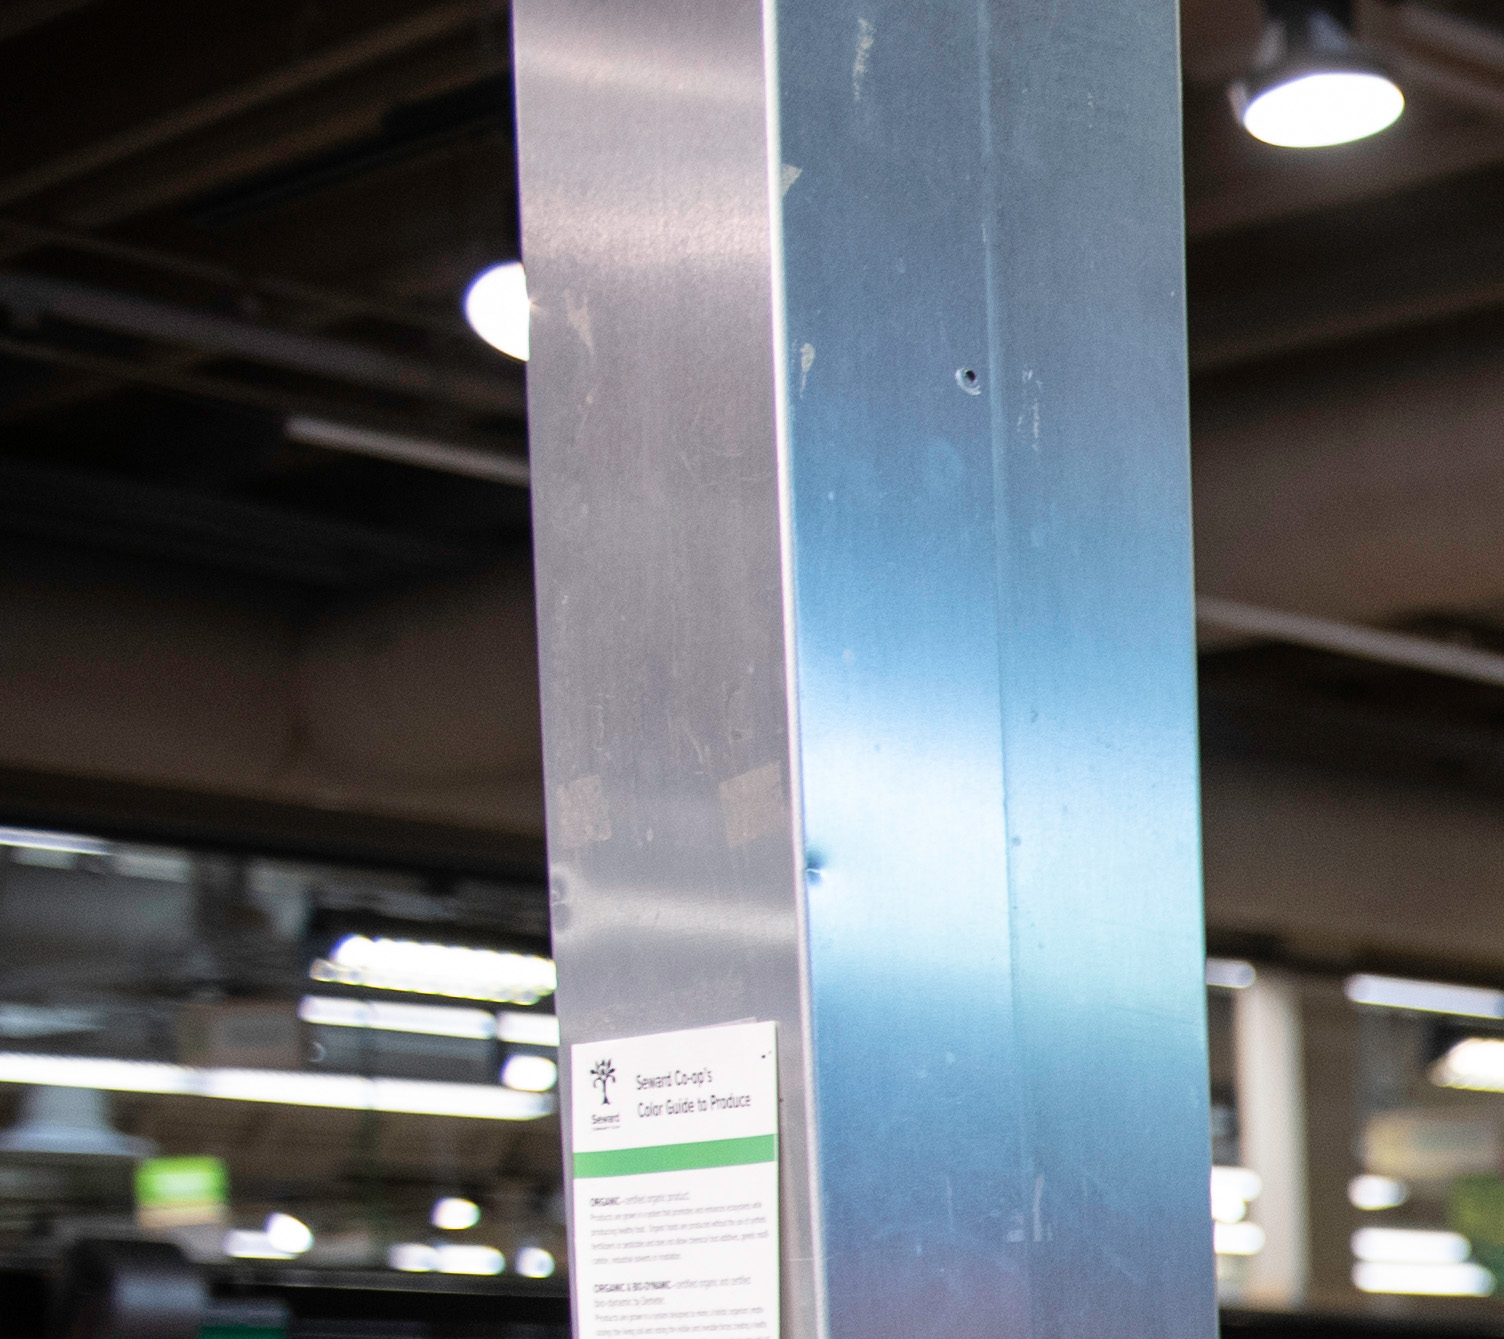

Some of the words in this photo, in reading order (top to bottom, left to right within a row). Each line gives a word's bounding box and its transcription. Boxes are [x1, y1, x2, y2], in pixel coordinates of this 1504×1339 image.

[636, 1072, 672, 1091] Seward
[674, 1068, 713, 1087] Co-op's
[637, 1101, 664, 1118] Color
[666, 1098, 695, 1115] Guide
[697, 1099, 708, 1112] to
[710, 1093, 751, 1111] Produce
